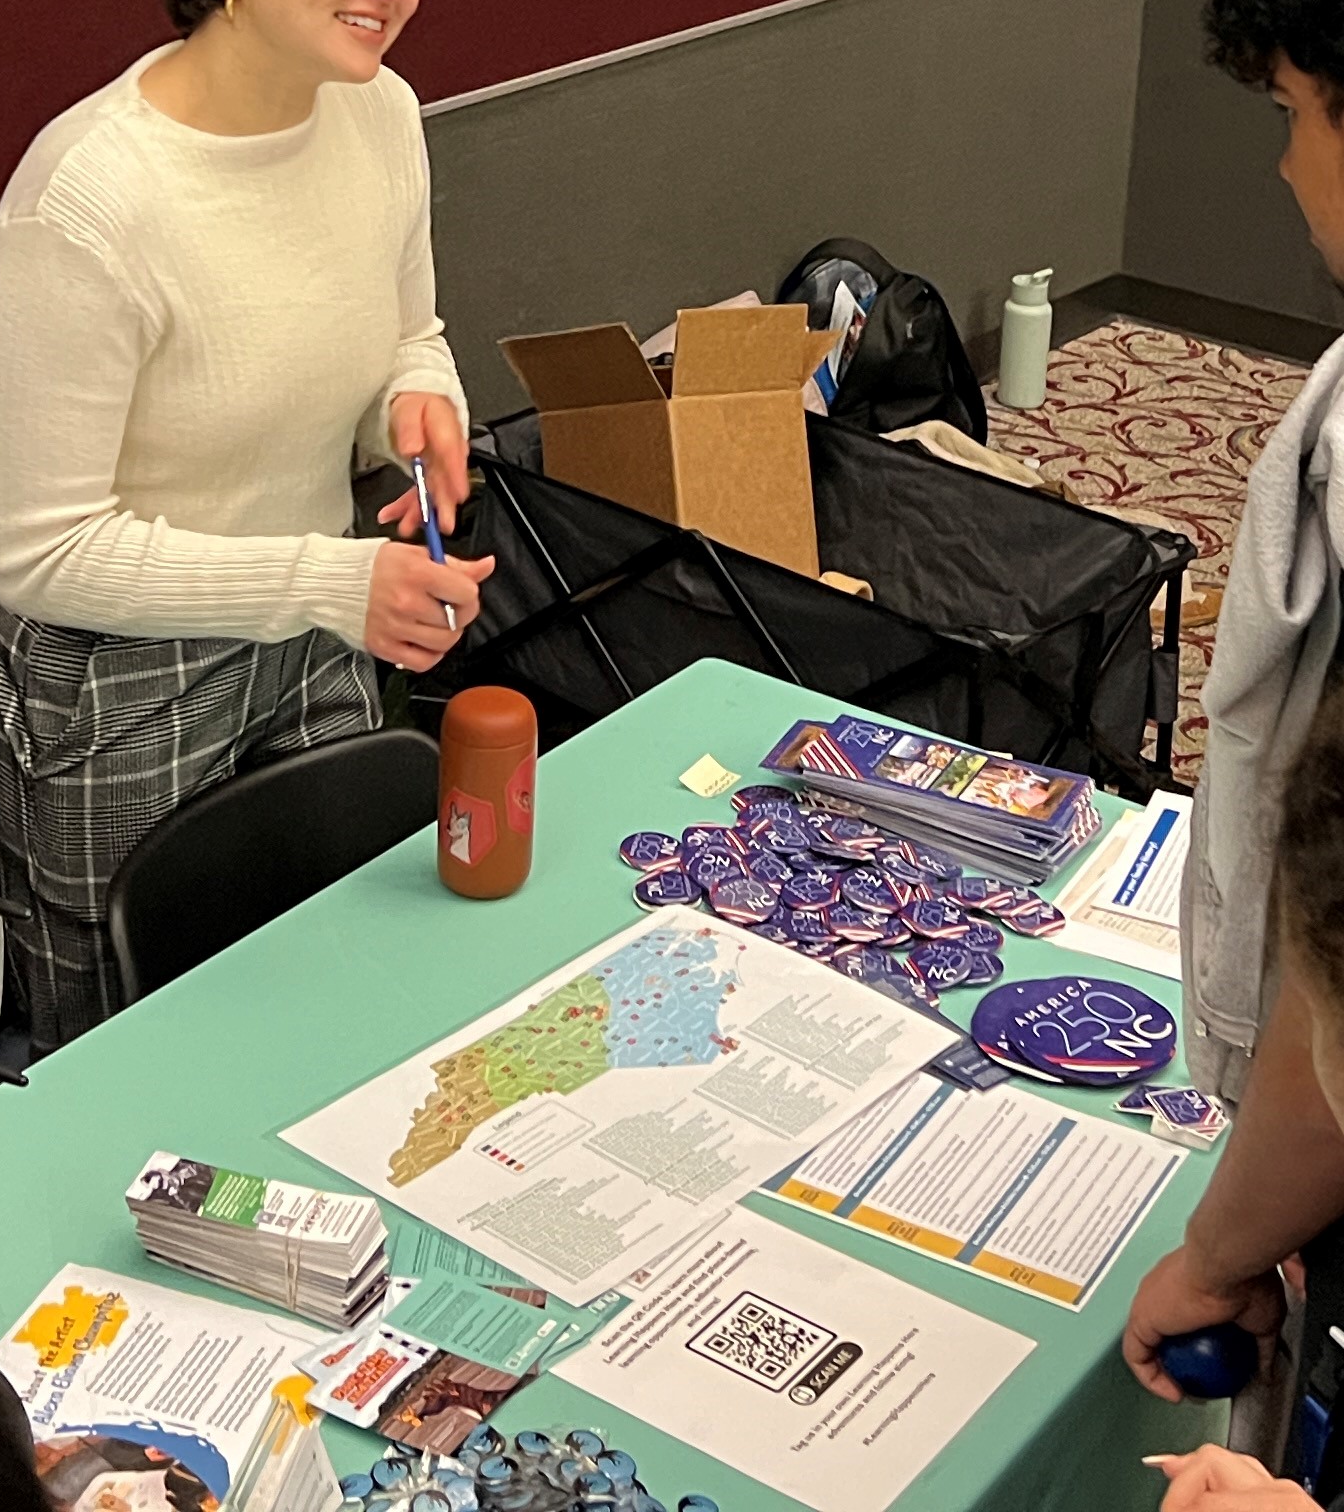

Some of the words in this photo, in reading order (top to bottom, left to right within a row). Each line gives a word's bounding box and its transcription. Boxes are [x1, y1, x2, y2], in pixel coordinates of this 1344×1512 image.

[871, 728, 894, 746] NC
[807, 812, 833, 828] NC
[660, 836, 677, 855] NC
[687, 828, 710, 846] NC
[764, 830, 785, 846] NC
[702, 853, 730, 867] NC
[854, 868, 883, 888] NC
[730, 879, 766, 906] 250
[746, 894, 776, 911] NC
[862, 913, 889, 928] NC
[943, 904, 960, 924] NC
[847, 954, 862, 977] NC
[916, 948, 966, 970] 250
[927, 966, 957, 982] NC
[1014, 979, 1092, 1027] AMERICA
[1032, 991, 1136, 1056] 250
[1104, 1014, 1172, 1058] NC
[1184, 1090, 1206, 1109] NC
[49, 1317, 76, 1350] Artist
[604, 1337, 636, 1363] Learning
[809, 1362, 840, 1388] SCAN
[833, 1349, 851, 1364] ME
[847, 1369, 879, 1396] Learning
